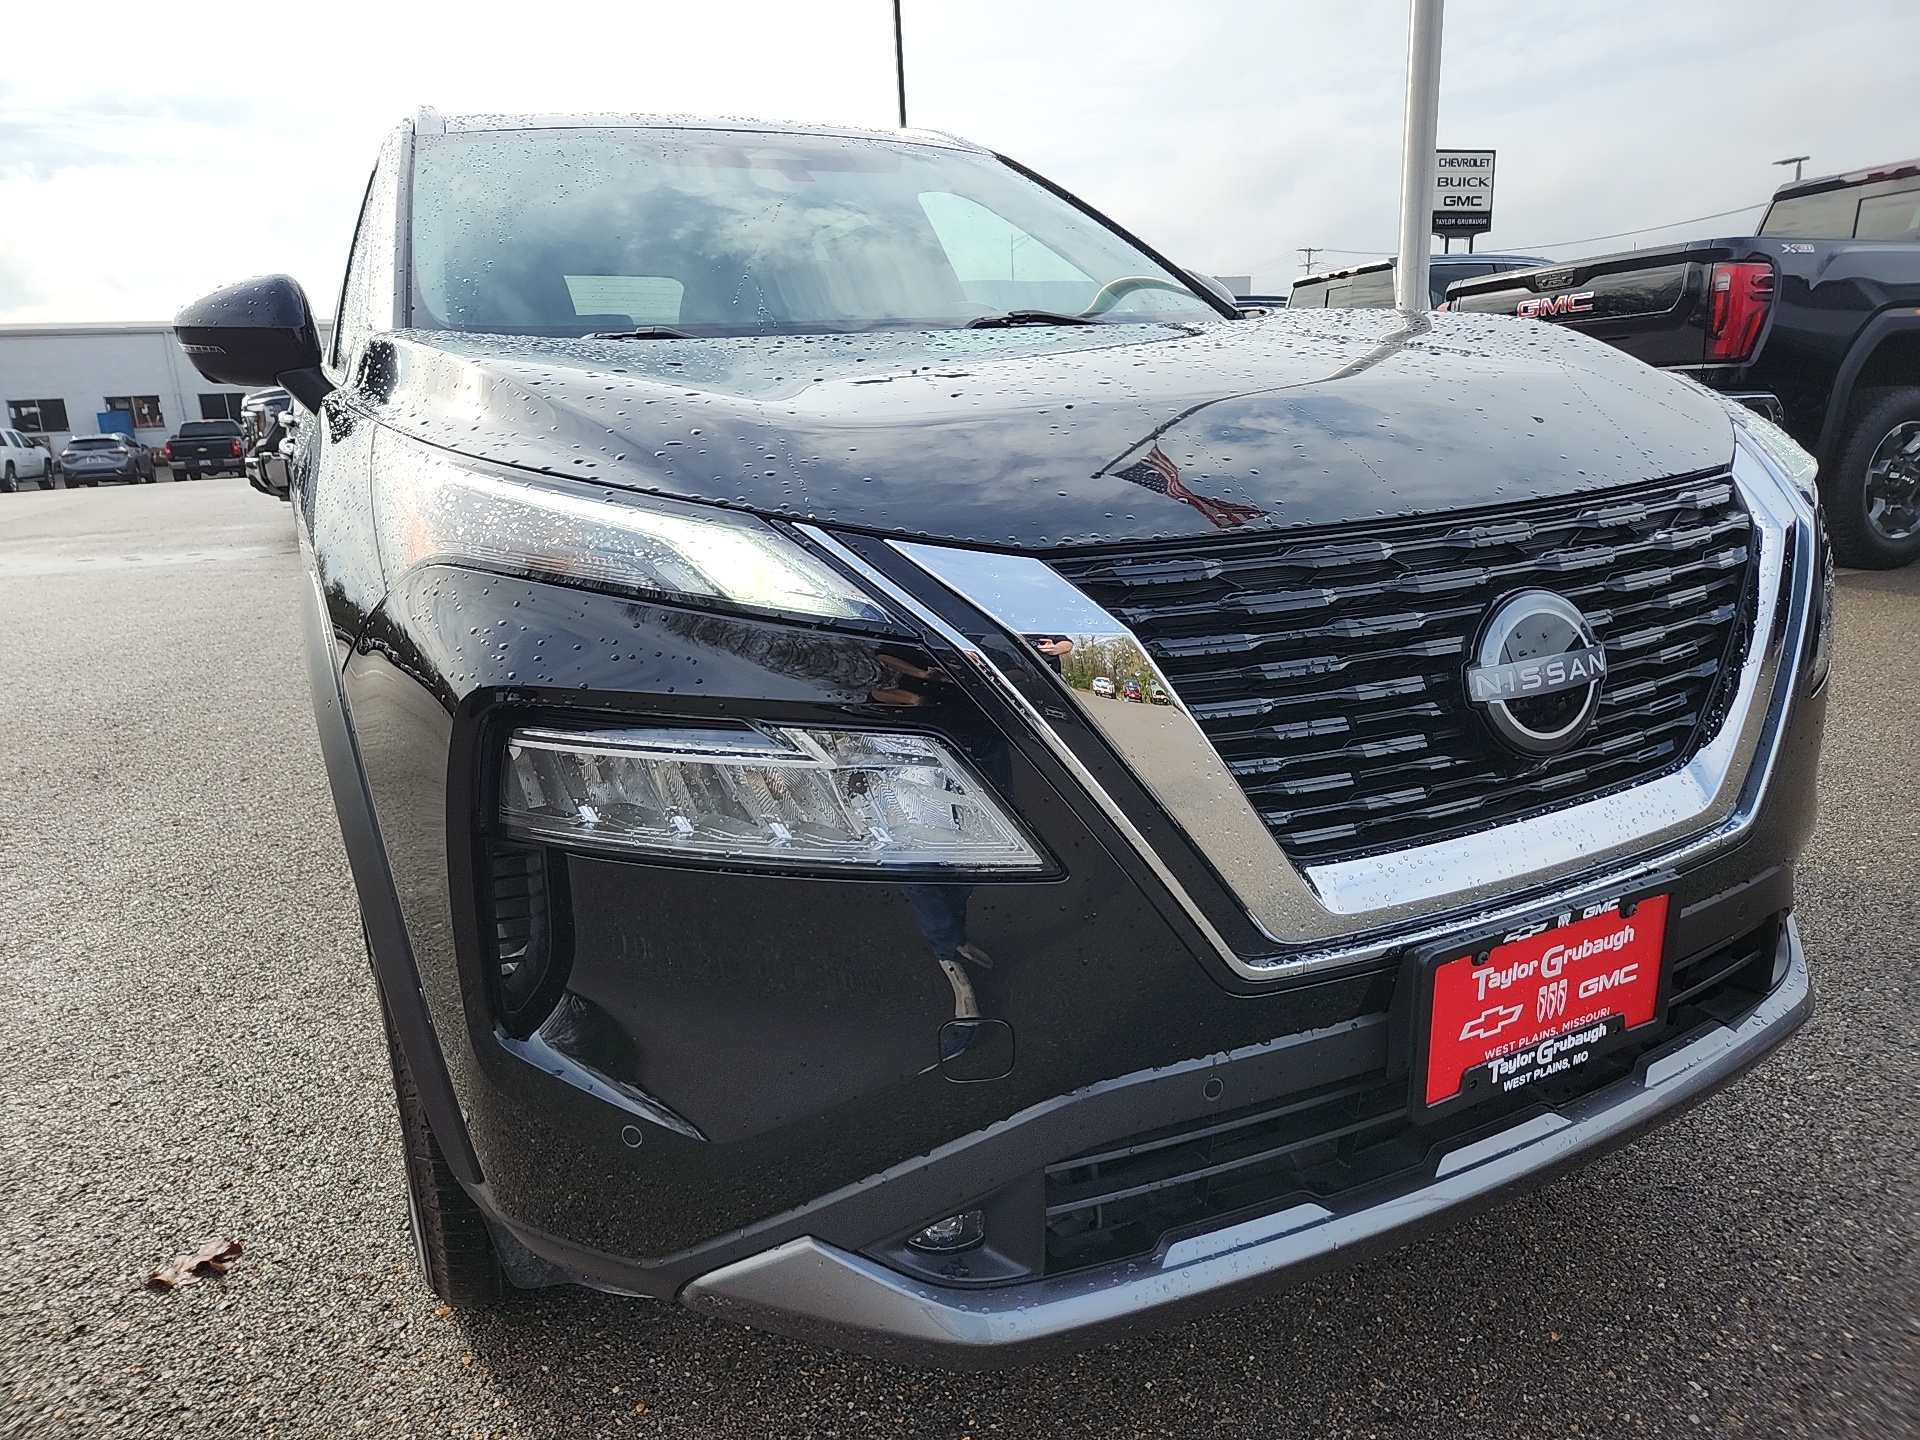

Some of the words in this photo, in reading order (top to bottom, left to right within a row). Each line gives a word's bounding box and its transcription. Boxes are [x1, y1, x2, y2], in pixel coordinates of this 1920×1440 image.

[1438, 157, 1491, 168] CHEVROLET
[1437, 176, 1490, 188] BUICK
[1443, 195, 1483, 207] GMC
[1436, 218, 1456, 226] TAYLOR
[1457, 218, 1488, 226] GRUBAUGH
[1517, 291, 1595, 319] GMC
[1475, 650, 1606, 697] NISSAN
[1582, 898, 1621, 920] GMC
[1471, 959, 1539, 1001] Taylor
[1540, 925, 1635, 979] Grubaugh
[1578, 963, 1639, 999] GMC
[1484, 1041, 1517, 1060] WEST
[1518, 1026, 1559, 1047] PLAINS,
[1561, 1006, 1611, 1033] MISSOURI
[1487, 1051, 1536, 1084] Taylor
[1536, 1023, 1607, 1065] Grubaugh
[1503, 1071, 1533, 1092] WEST
[1533, 1057, 1571, 1080] PLAINS,
[1572, 1050, 1589, 1067] MO
